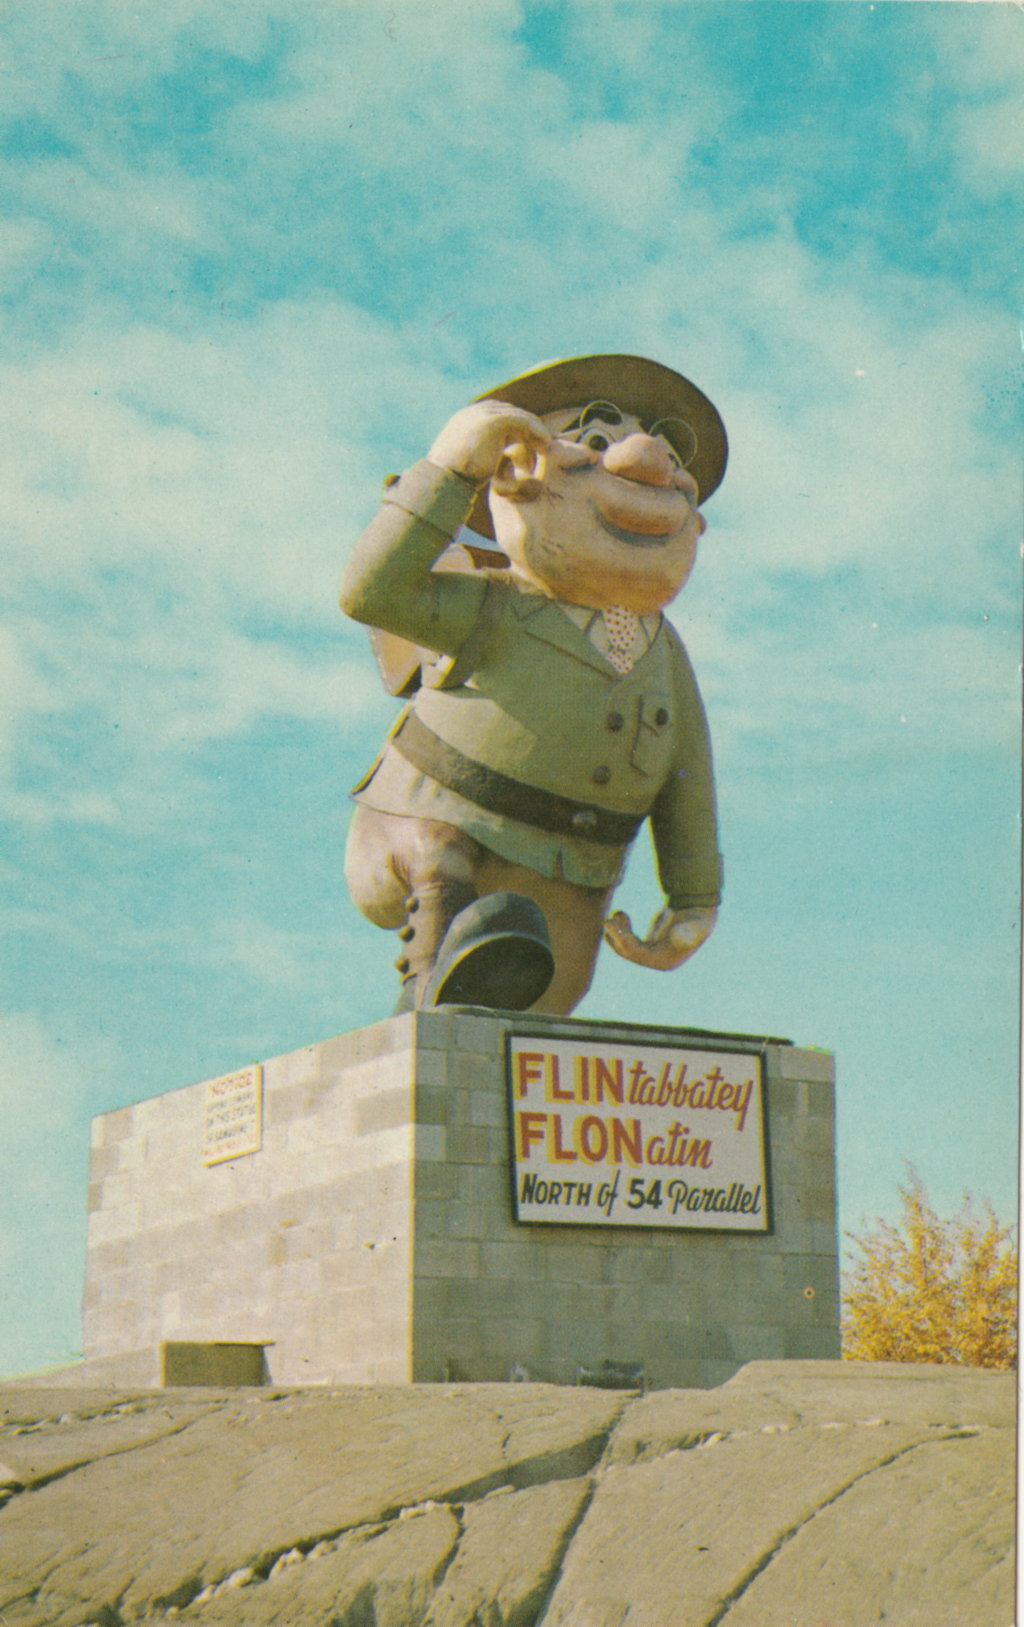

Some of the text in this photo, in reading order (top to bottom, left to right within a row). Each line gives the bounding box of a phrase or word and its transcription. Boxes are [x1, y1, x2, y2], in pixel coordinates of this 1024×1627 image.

[520, 1169, 762, 1217] NORTH of 54 Parallel
